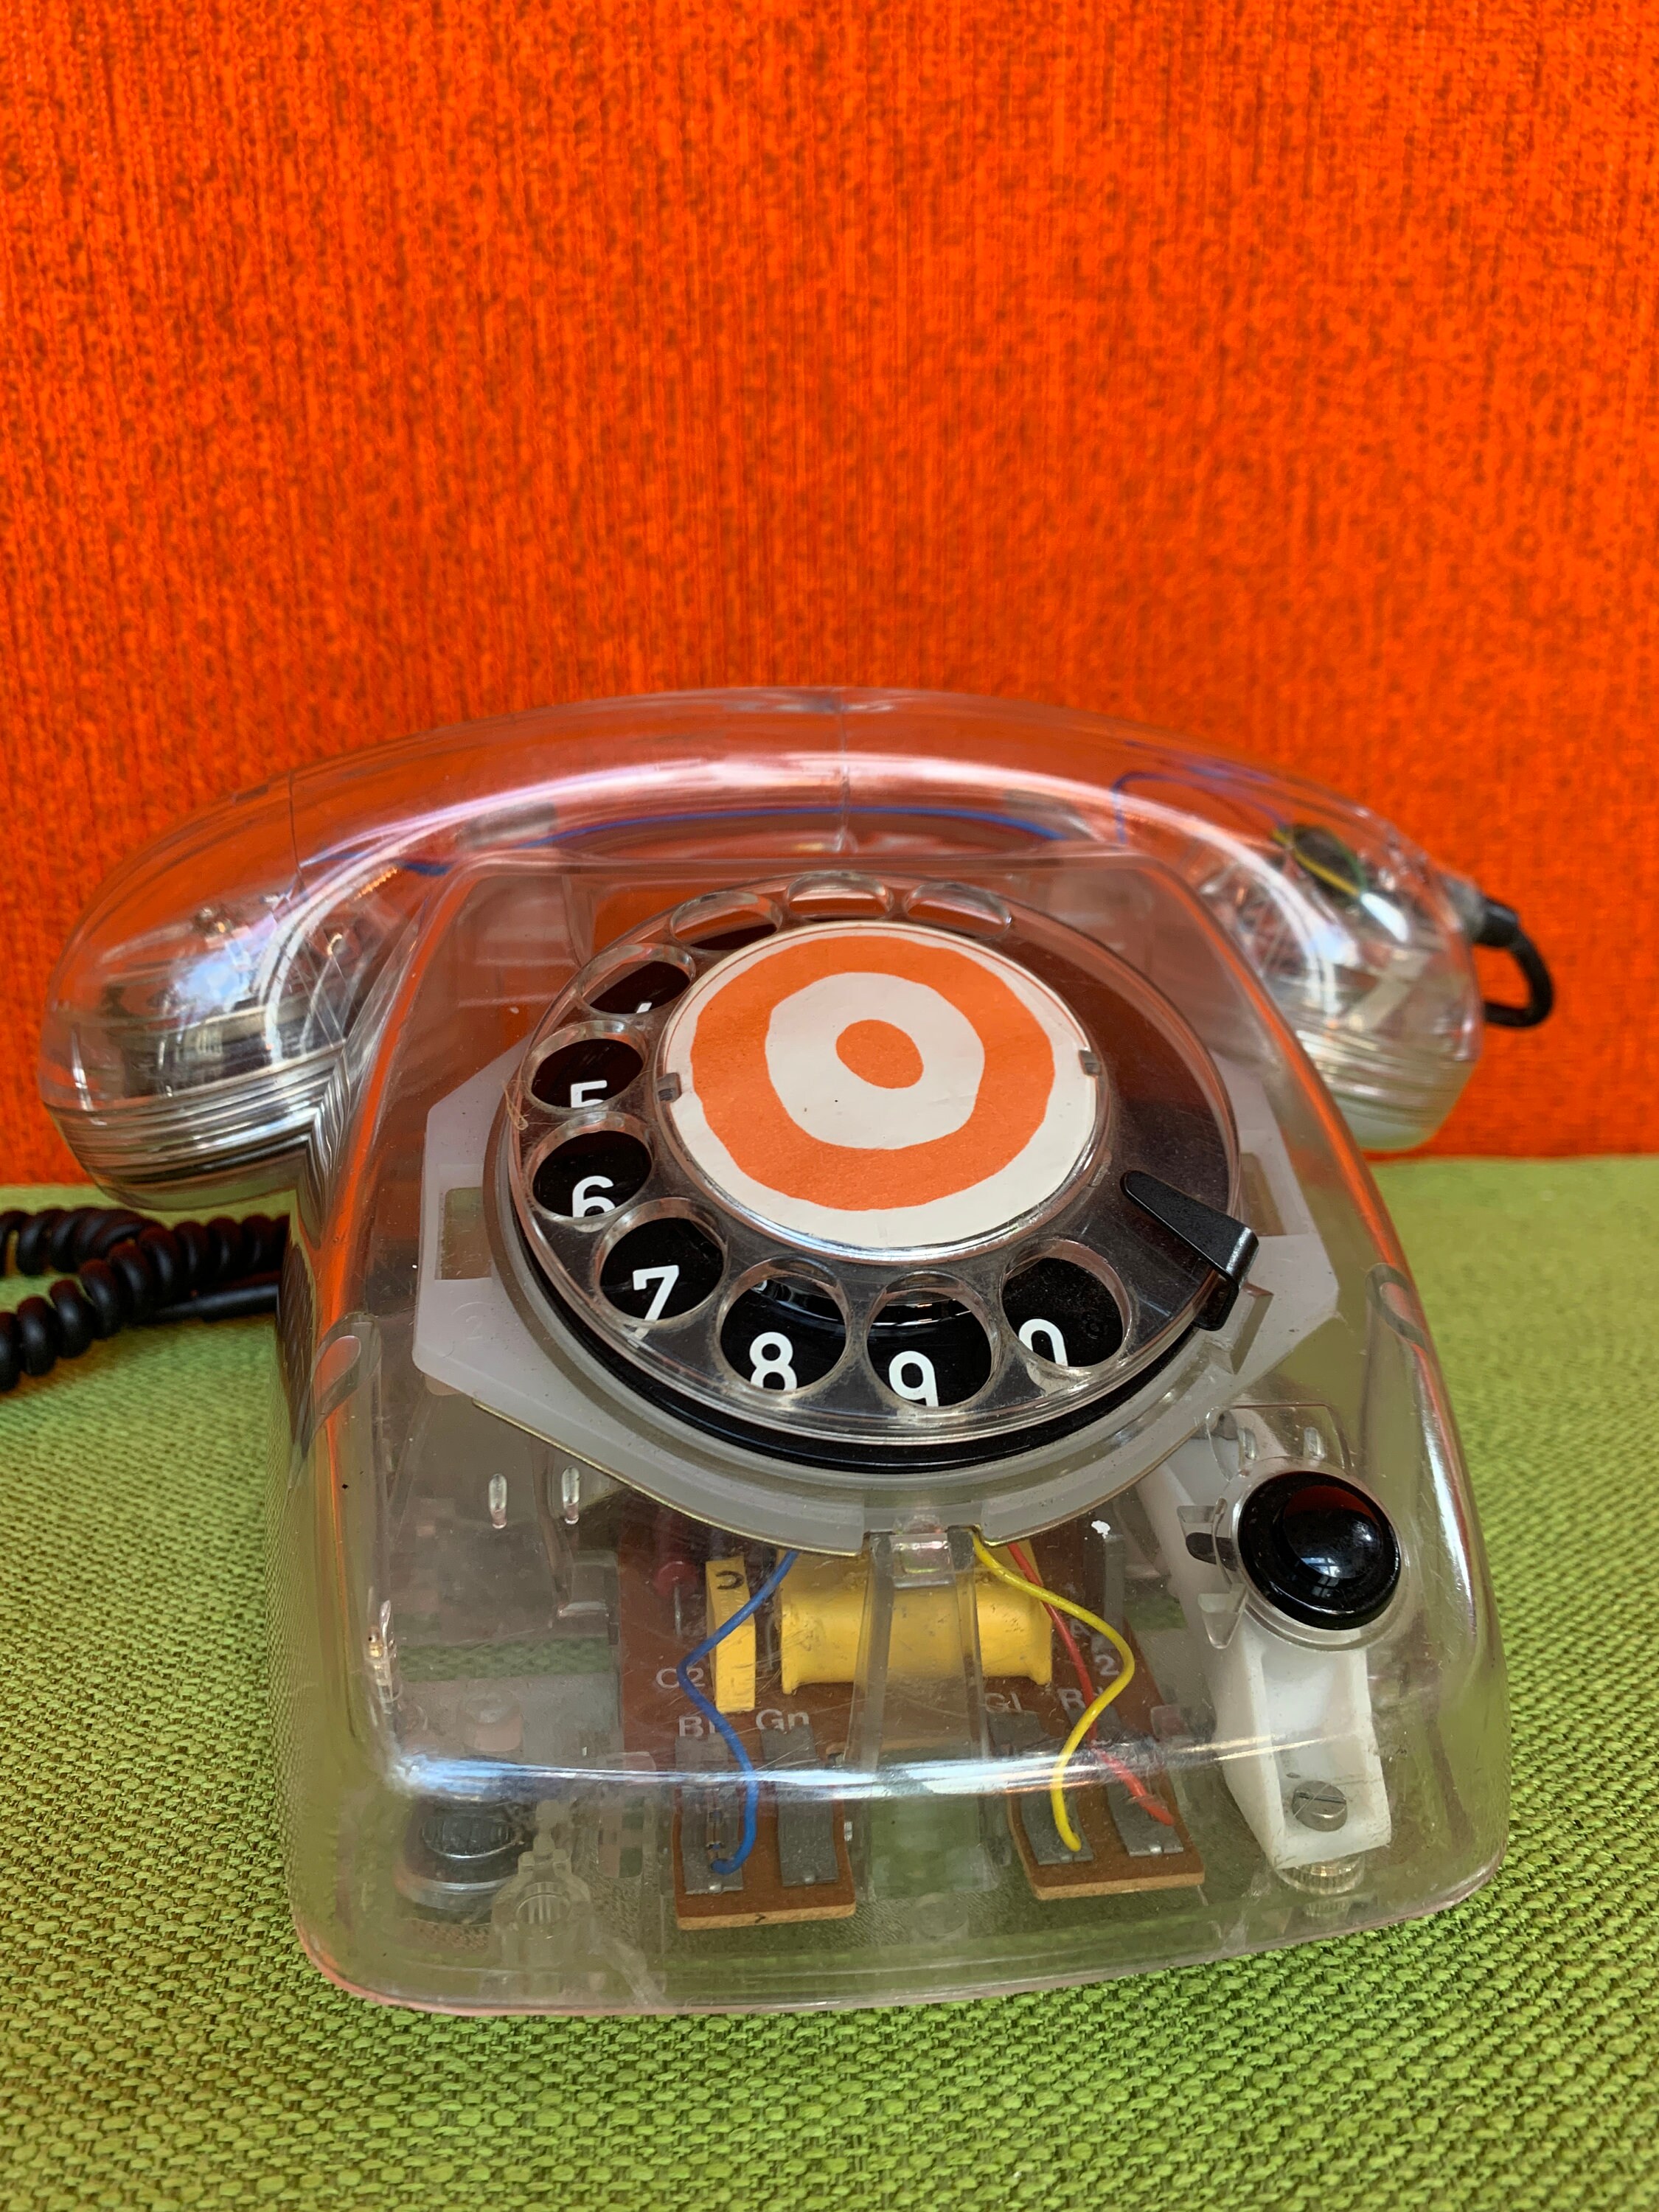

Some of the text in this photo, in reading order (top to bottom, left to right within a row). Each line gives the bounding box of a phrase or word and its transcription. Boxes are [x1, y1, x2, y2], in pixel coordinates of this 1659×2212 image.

[571, 1080, 608, 1108] 5
[572, 1175, 616, 1217] 6
[632, 1265, 680, 1322] 7
[749, 1332, 798, 1391] 8
[888, 1350, 939, 1408] 9
[655, 1667, 706, 1689] C2
[756, 1708, 810, 1732] Gn
